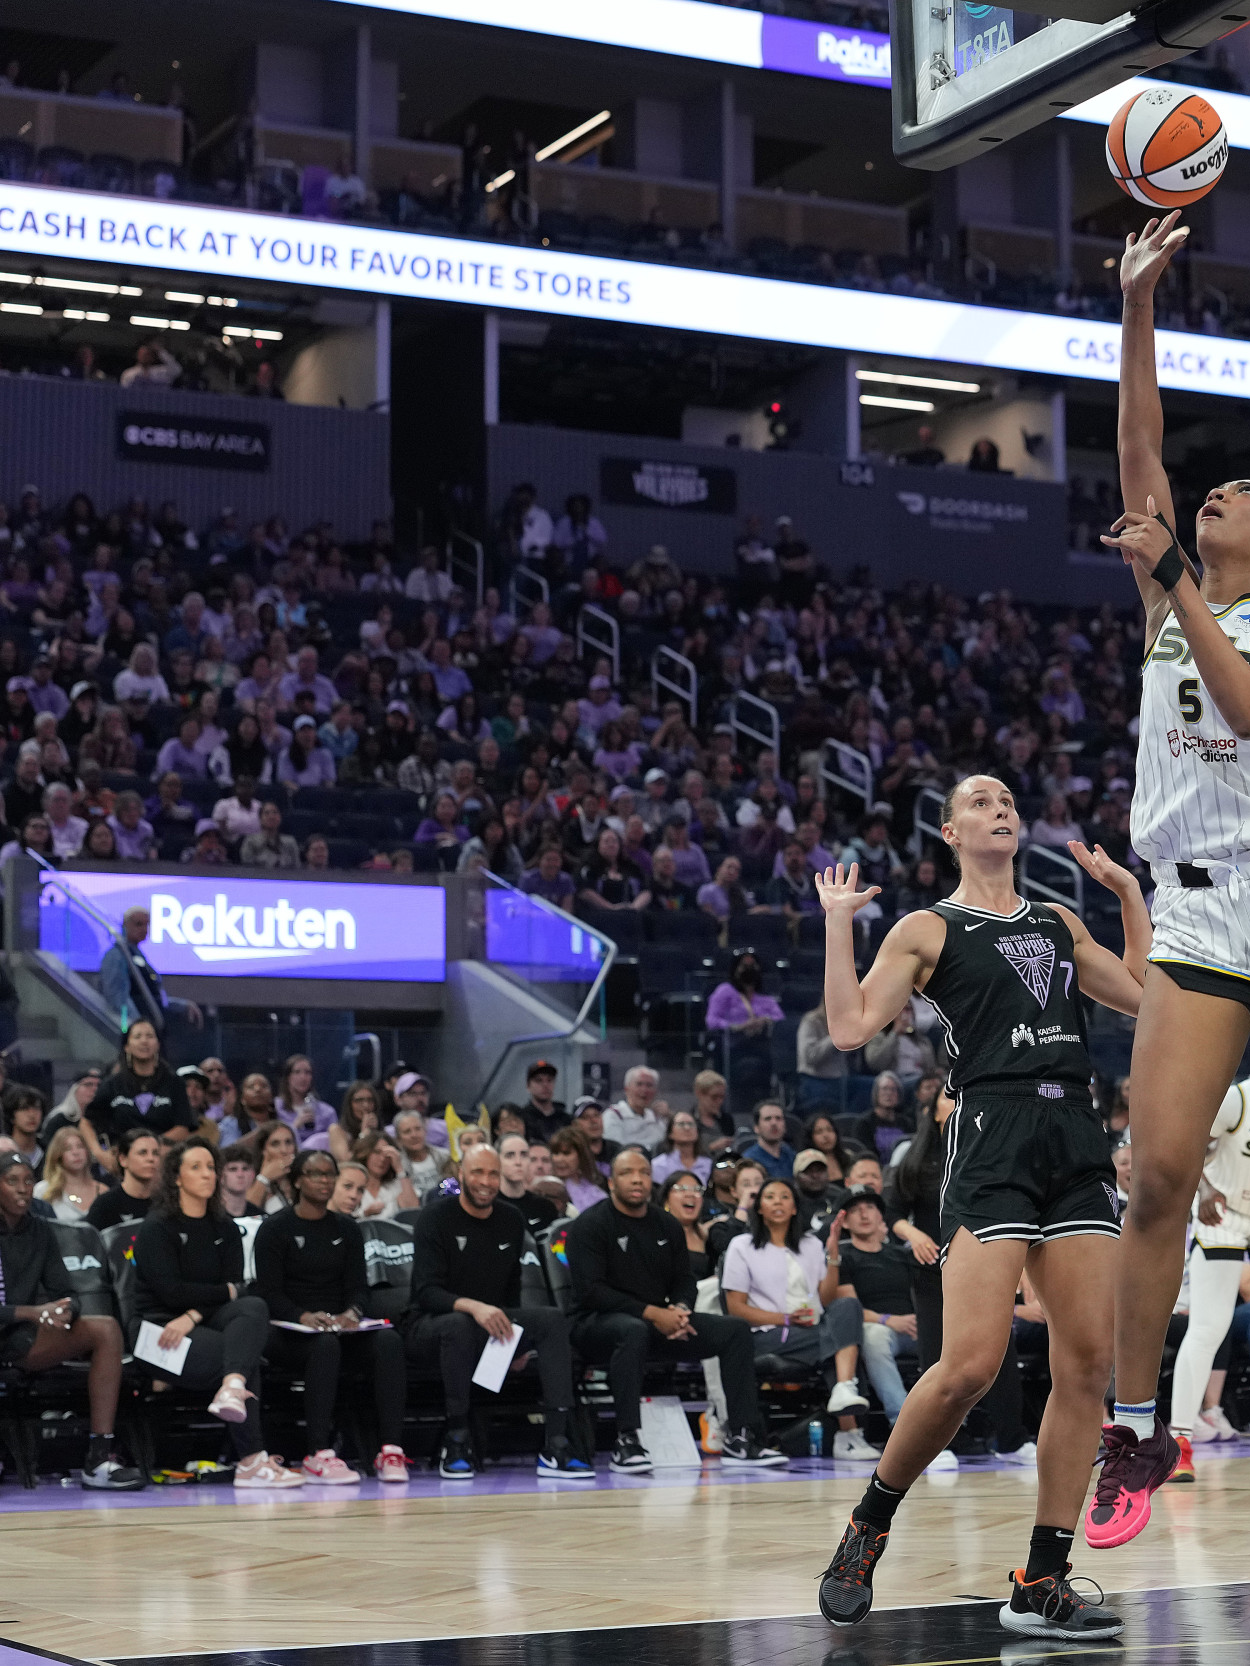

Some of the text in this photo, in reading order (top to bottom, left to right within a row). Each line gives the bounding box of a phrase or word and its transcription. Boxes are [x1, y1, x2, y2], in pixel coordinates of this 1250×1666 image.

[0, 207, 632, 305] CASH BACK AT YOUR FAVORITE STORES
[1066, 338, 1121, 364] CAS
[1156, 349, 1211, 376] ACK
[1220, 358, 1250, 380] AT
[1178, 678, 1204, 724] 5
[149, 893, 356, 950] Rakuten
[993, 938, 1056, 957] VALKYRIES
[1060, 961, 1073, 1000] 7
[1037, 1025, 1062, 1036] KAISER
[1039, 1034, 1081, 1044] PERMANENTE
